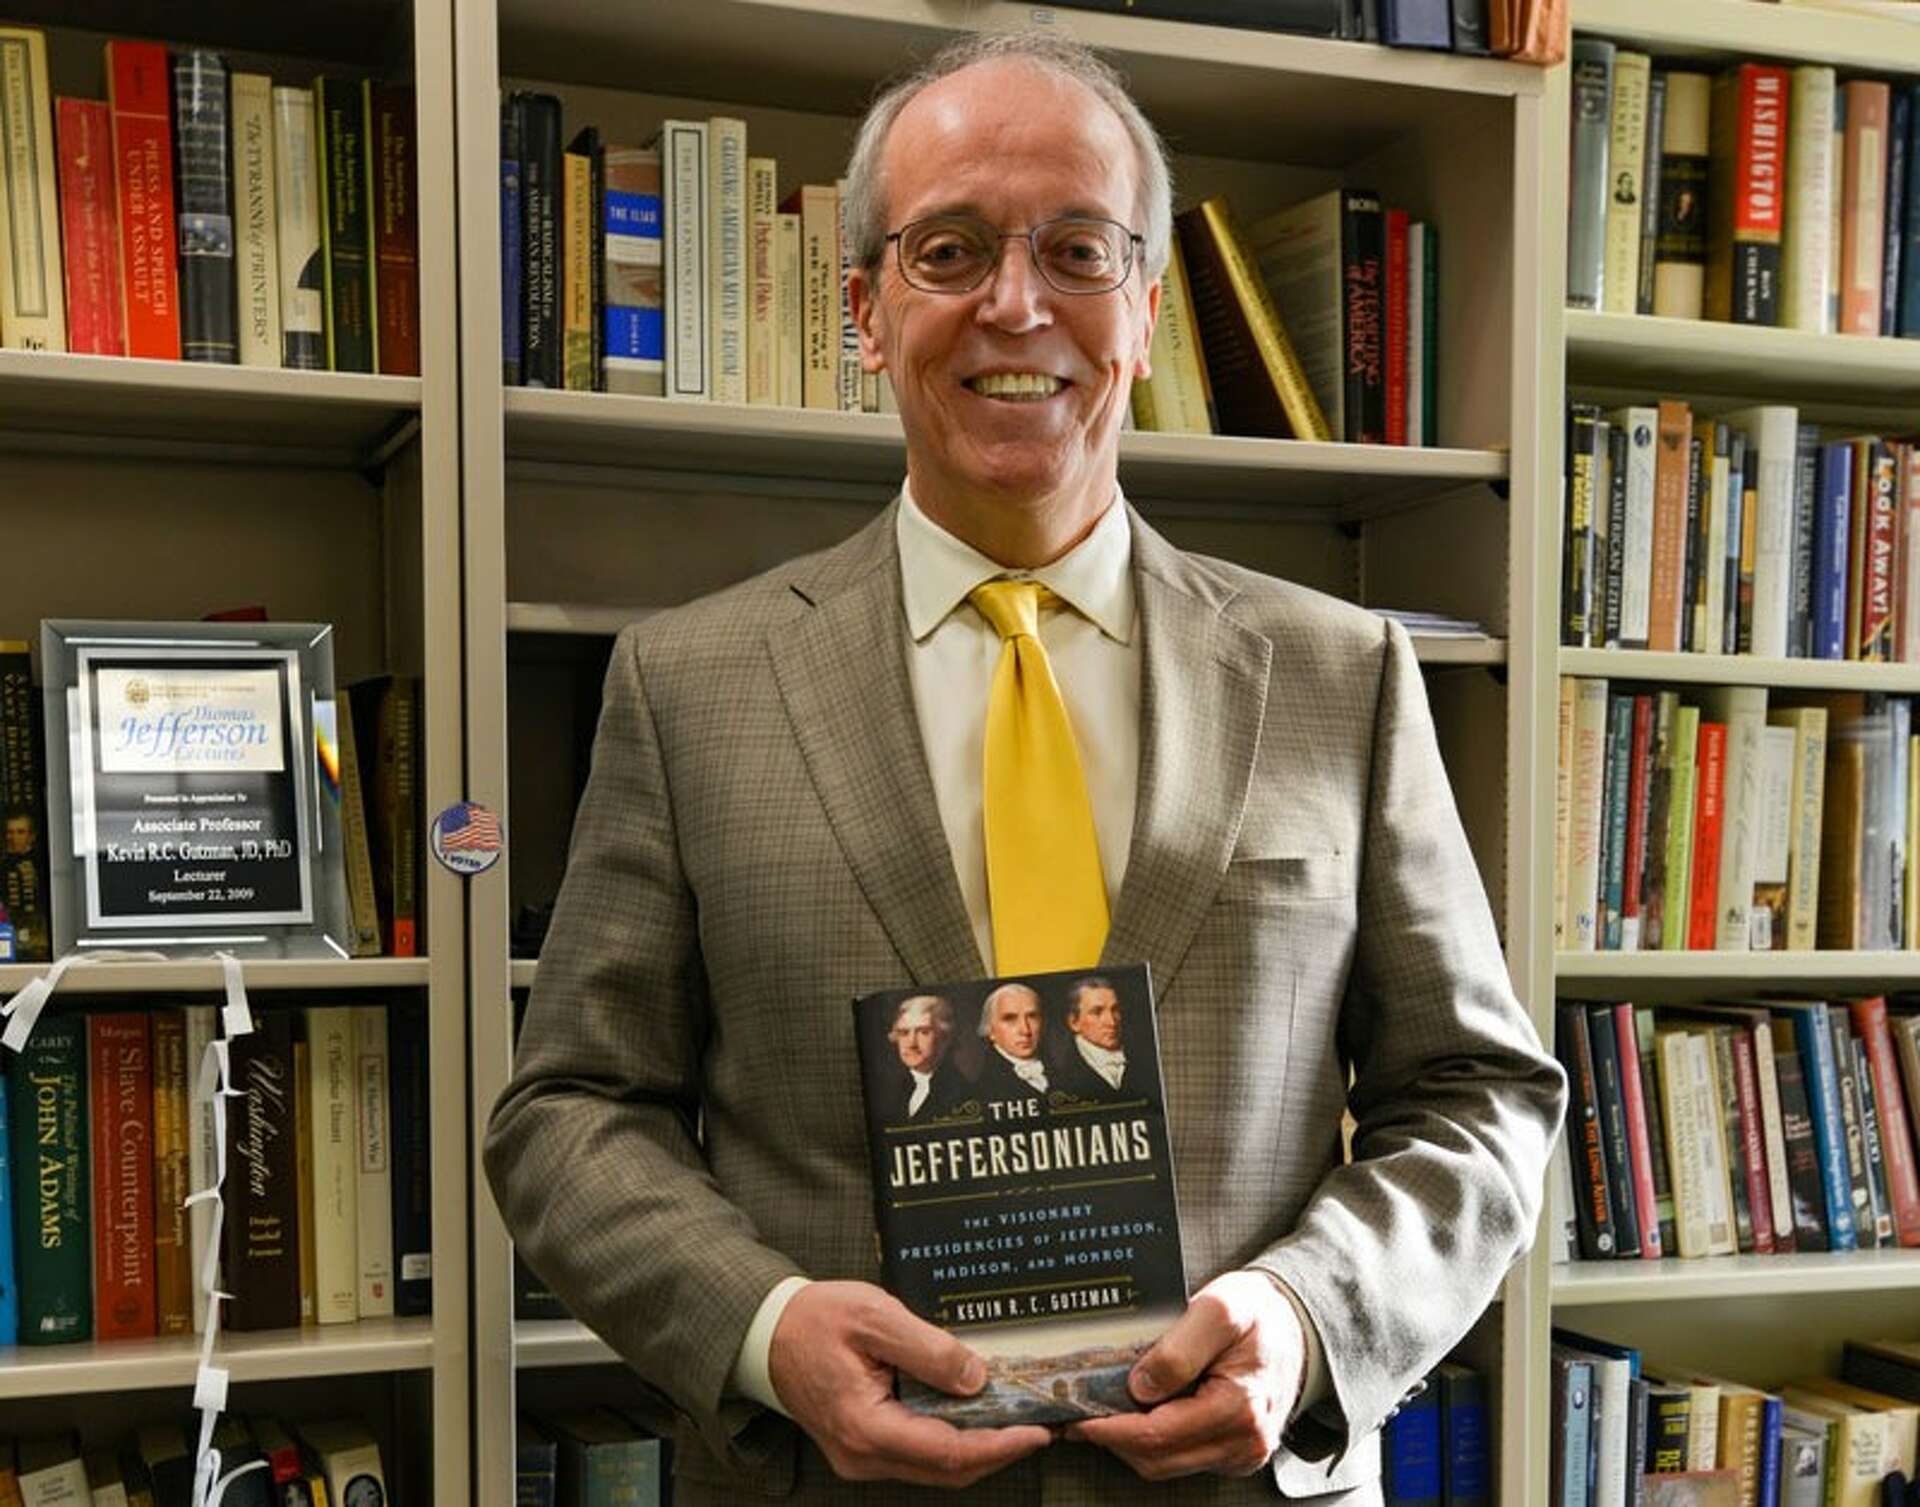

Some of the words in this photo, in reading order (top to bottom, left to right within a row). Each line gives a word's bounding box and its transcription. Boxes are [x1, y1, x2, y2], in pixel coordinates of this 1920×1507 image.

[1616, 86, 1629, 143] HENRY
[144, 139, 162, 192] PRESS
[682, 146, 694, 171] THE
[722, 136, 739, 196] CLOSING
[1750, 77, 1781, 221] WASHINGTON
[126, 150, 143, 215] UNDER
[248, 147, 265, 230] TYRANNY
[683, 178, 694, 214] JOHN
[148, 203, 164, 240] AND
[528, 189, 541, 259] AMERICAN
[683, 221, 695, 276] LENNON
[722, 207, 740, 277] AMERICAN
[131, 223, 149, 304] ASSAULT
[541, 220, 554, 303] RADICALISM
[810, 236, 820, 269] THE
[150, 246, 168, 316] SPEECH
[528, 261, 541, 349] REVOLUTION
[722, 280, 740, 320] MIND
[810, 277, 821, 326] CIVIL
[1747, 247, 1758, 320] CHERNOW
[1760, 270, 1771, 299] RON
[683, 281, 695, 341] LETTERS
[819, 293, 830, 350] Coming
[1349, 282, 1366, 375] AMERICA
[1365, 287, 1380, 385] TEMPTING
[810, 332, 821, 370] WAR
[1799, 457, 1815, 530] LIBERTY
[1876, 458, 1895, 531] LOOK
[1609, 488, 1624, 569] AMERICAN
[1873, 539, 1891, 613] AWAY!
[1607, 575, 1622, 632] JEZEBEL
[115, 711, 269, 757] Jefferson
[190, 704, 256, 720] Thomas
[105, 842, 145, 862] Kevin
[147, 842, 177, 861] R.C.
[179, 843, 238, 862] Gutzman,
[240, 841, 262, 861] JD,
[265, 839, 291, 858] PhD
[132, 817, 197, 833] Associate
[199, 817, 262, 832] Professor
[148, 888, 205, 903] September
[207, 887, 226, 902] 22,
[228, 887, 255, 901] 2009
[174, 868, 227, 883] Lecturer
[63, 1073, 77, 1096] The
[118, 1047, 146, 1113] Slave
[1841, 1076, 1858, 1124] George
[29, 1072, 64, 1145] JOHN
[65, 1101, 80, 1150] Political
[236, 1058, 286, 1197] Washington
[988, 1098, 1041, 1120] THE
[890, 1120, 1152, 1188] JEFFERSONIANS
[1585, 1147, 1601, 1182] LONG
[1846, 1124, 1864, 1177] Clinton
[38, 1155, 64, 1249] ADAMS
[64, 1153, 82, 1204] Writings
[114, 1120, 147, 1288] Counterpoint
[1592, 1183, 1608, 1223] AFFAIR
[64, 1206, 81, 1221] of
[964, 1218, 990, 1229] THE
[999, 1204, 1093, 1224] VISIONARY
[900, 1235, 1025, 1261] PRESIDENCIES
[1033, 1234, 1050, 1245] OF
[1060, 1221, 1163, 1242] JEFFERSON,
[932, 1261, 1019, 1281] MADISON,
[1027, 1258, 1056, 1269] AND
[1064, 1247, 1136, 1265] MONROE
[956, 1298, 1003, 1321] KEVIN
[1009, 1299, 1025, 1316] R.
[1029, 1297, 1046, 1313] C.
[1049, 1286, 1120, 1312] GUTZMAN
